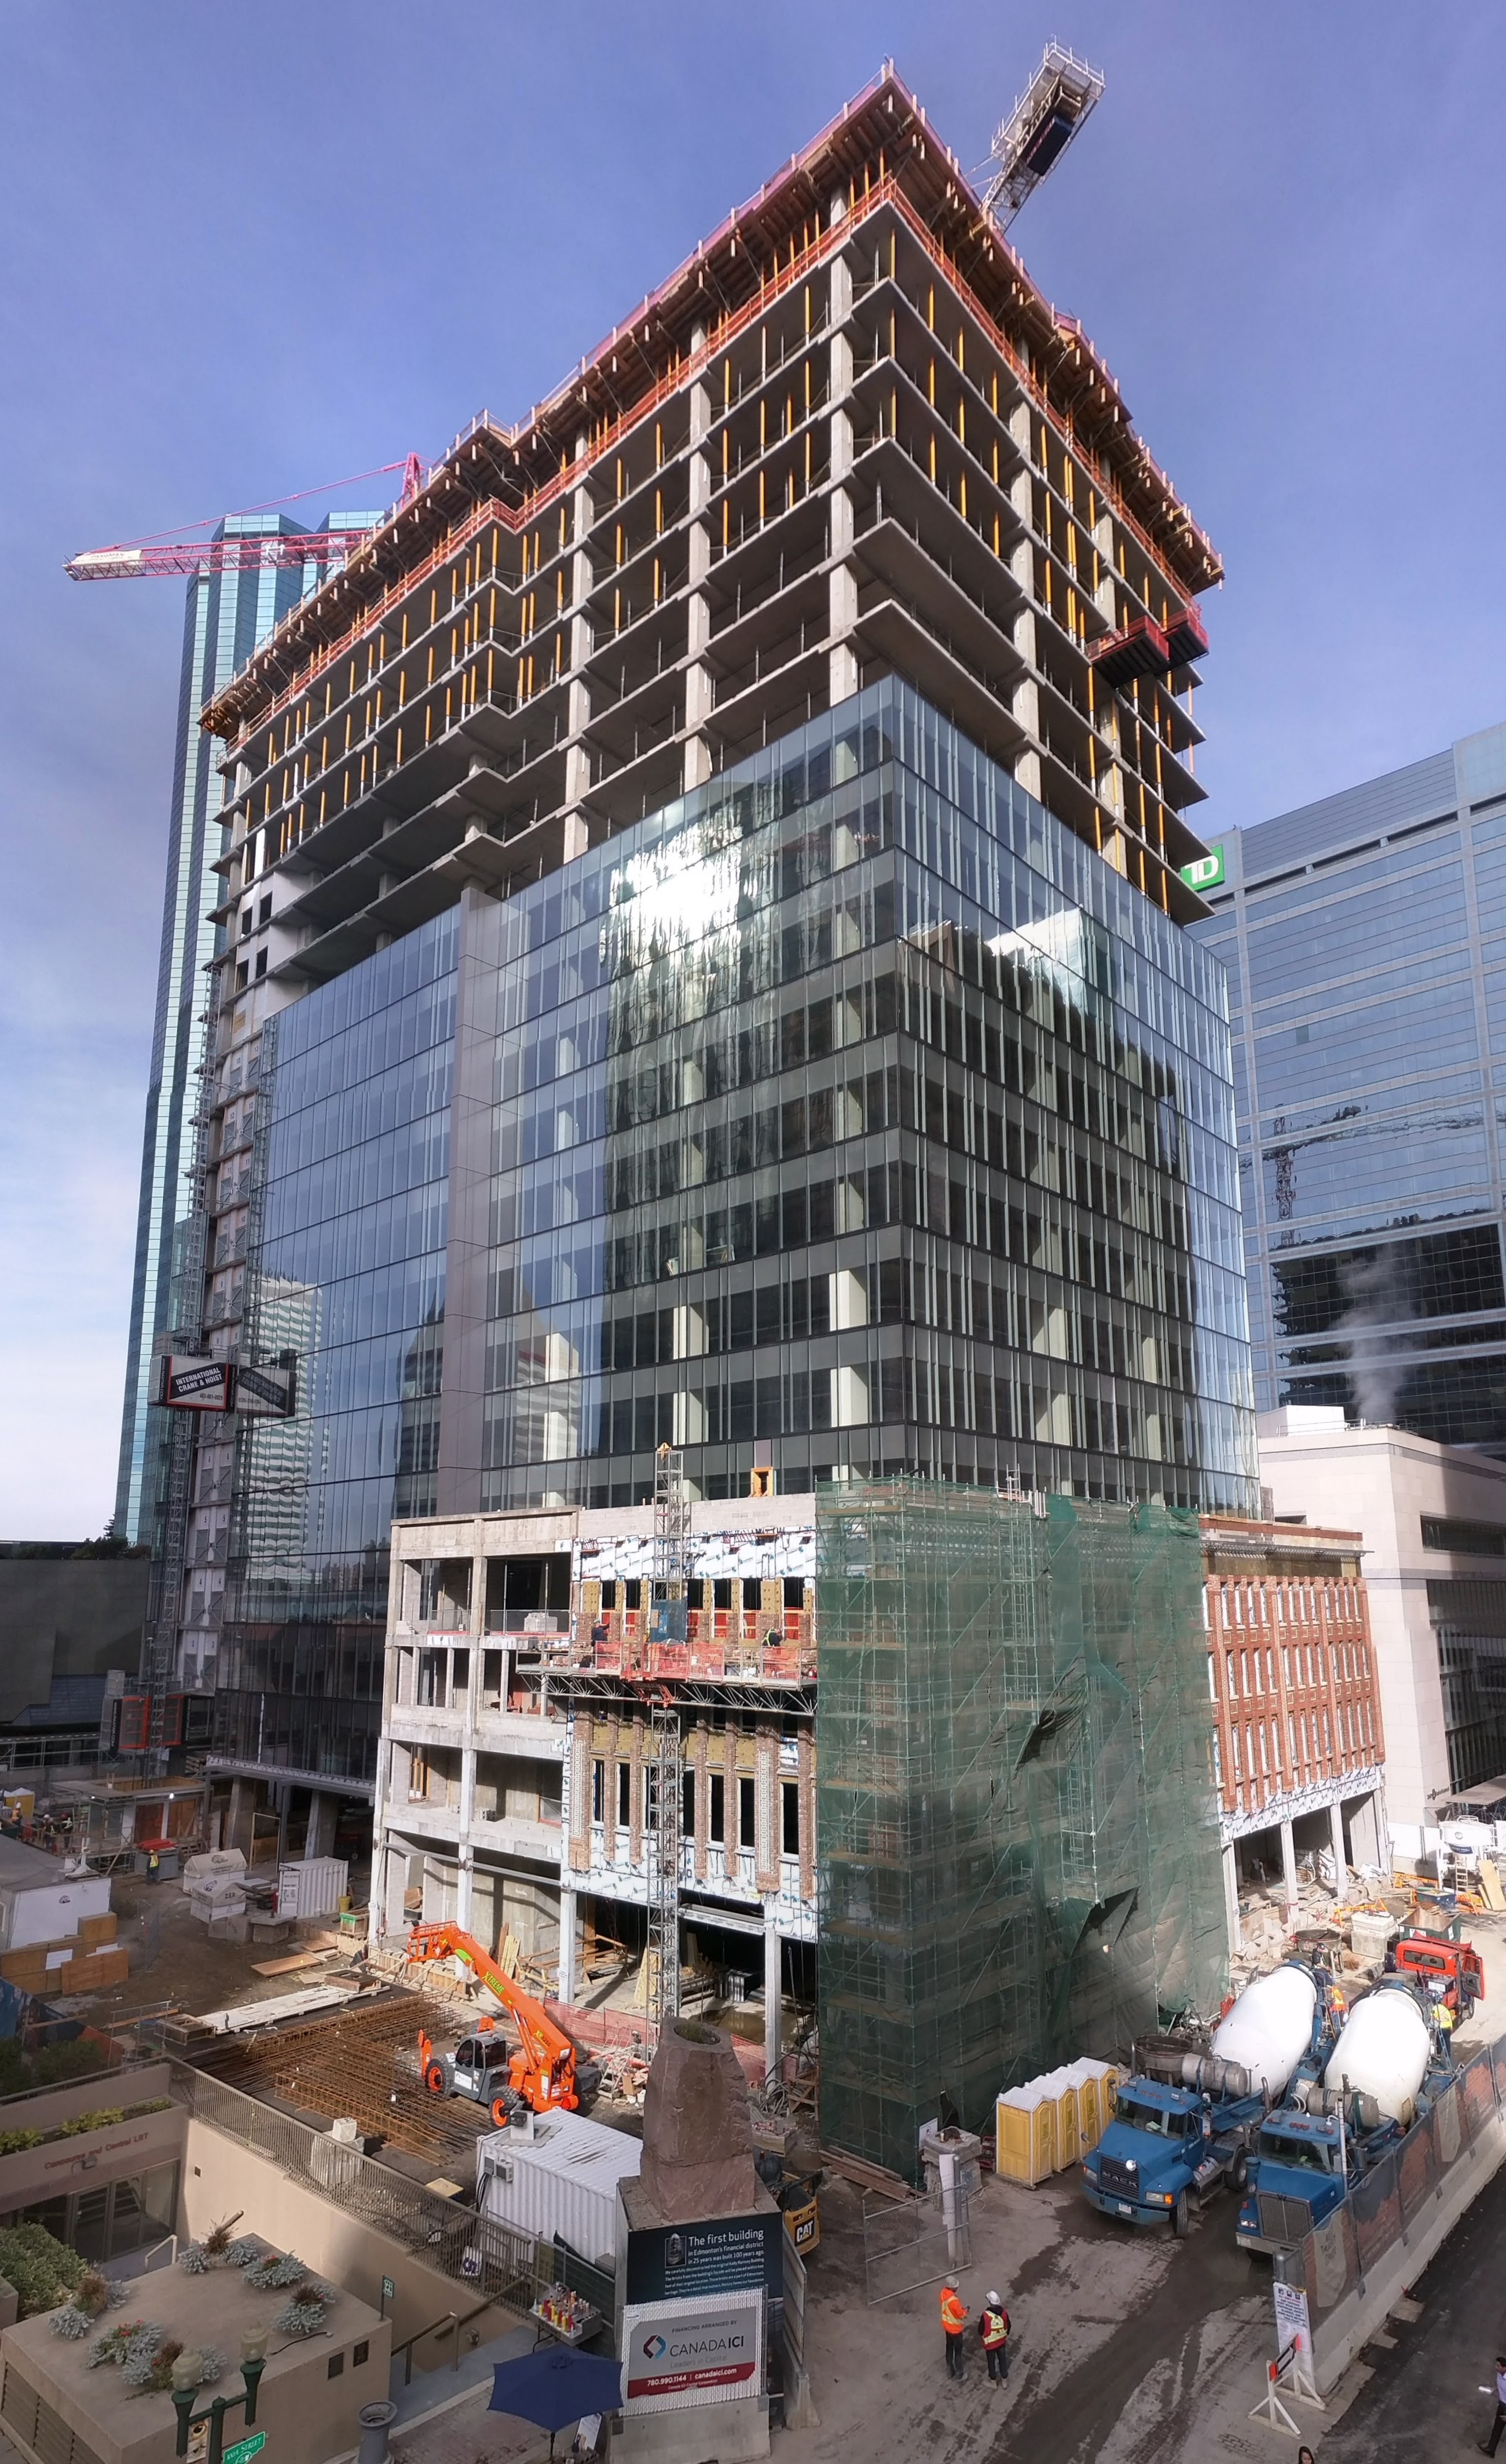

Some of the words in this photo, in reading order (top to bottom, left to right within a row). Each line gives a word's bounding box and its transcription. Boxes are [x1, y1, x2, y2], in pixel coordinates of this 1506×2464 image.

[1184, 855, 1219, 884] TD
[175, 1367, 221, 1385] INTERNATIONAL
[178, 1381, 199, 1392] CRANE
[205, 1374, 222, 1384] HOIST
[481, 1971, 505, 1994] XTREME
[105, 2137, 131, 2151] Central
[134, 2132, 149, 2143] LRT
[1102, 2172, 1137, 2187] MACK
[688, 2236, 705, 2246] The
[708, 2233, 727, 2244] first
[728, 2229, 764, 2241] building
[797, 2220, 814, 2242] CAT
[694, 2246, 723, 2256] Edmonton's
[724, 2243, 745, 2251] financial
[672, 2324, 700, 2333] FINANCING
[701, 2320, 729, 2328] ARRANGED
[670, 2360, 696, 2368] Leaders
[705, 2355, 727, 2363] Capital
[647, 2375, 687, 2386] 780.990.1144
[695, 2368, 737, 2379] canadaici.com
